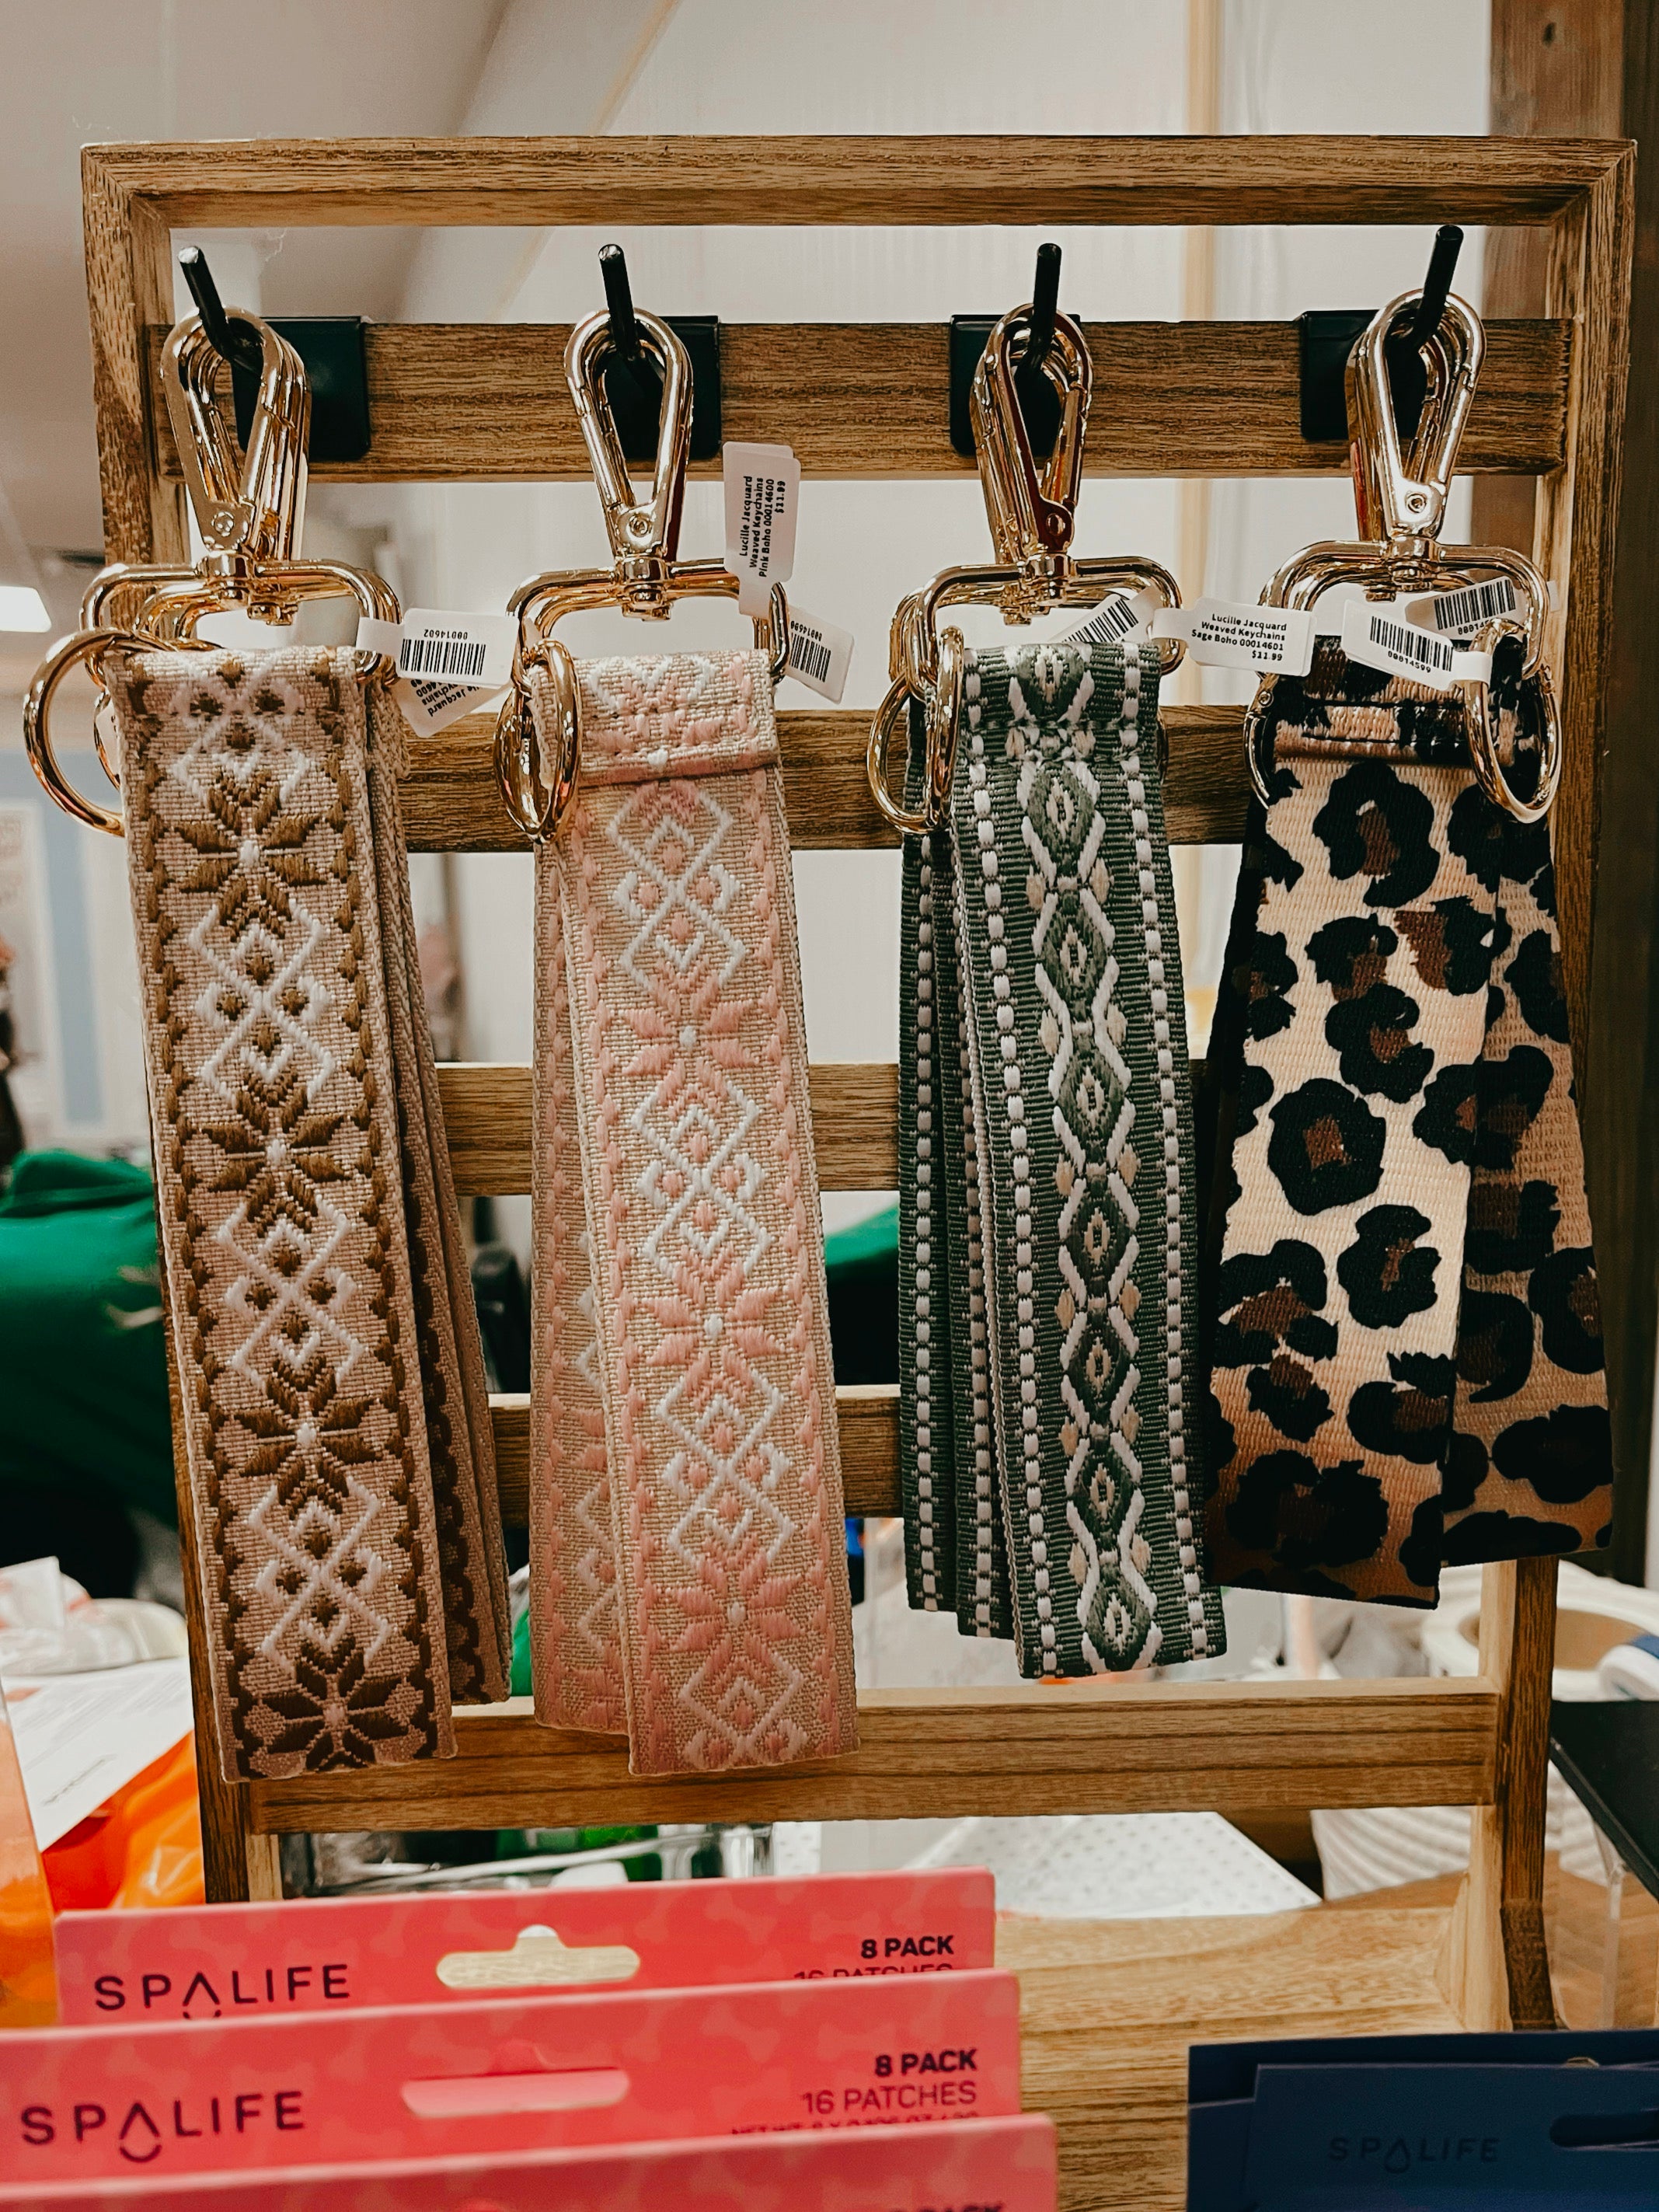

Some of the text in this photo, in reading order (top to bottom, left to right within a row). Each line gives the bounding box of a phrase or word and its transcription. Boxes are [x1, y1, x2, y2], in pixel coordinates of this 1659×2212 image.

[775, 480, 786, 514] $11.99
[740, 476, 752, 556] Lucille Jacquard
[750, 477, 764, 568] Weaved Keychains
[758, 479, 775, 577] Pink Boho 00014600
[423, 629, 468, 640] 00014602
[1201, 621, 1285, 641] Weaved Keychains
[1211, 613, 1287, 631] Lucille Jacquard
[1191, 629, 1284, 651] Sage Boho 00014601
[1252, 650, 1283, 661] $11.99
[1388, 651, 1431, 673] 00014599
[427, 689, 466, 717] Jacquard
[860, 1935, 953, 1959] 8 PACK
[875, 2047, 978, 2078] 8 PACK
[801, 2081, 977, 2114] 16 PATCHES
[20, 2091, 305, 2162] SPALIFE
